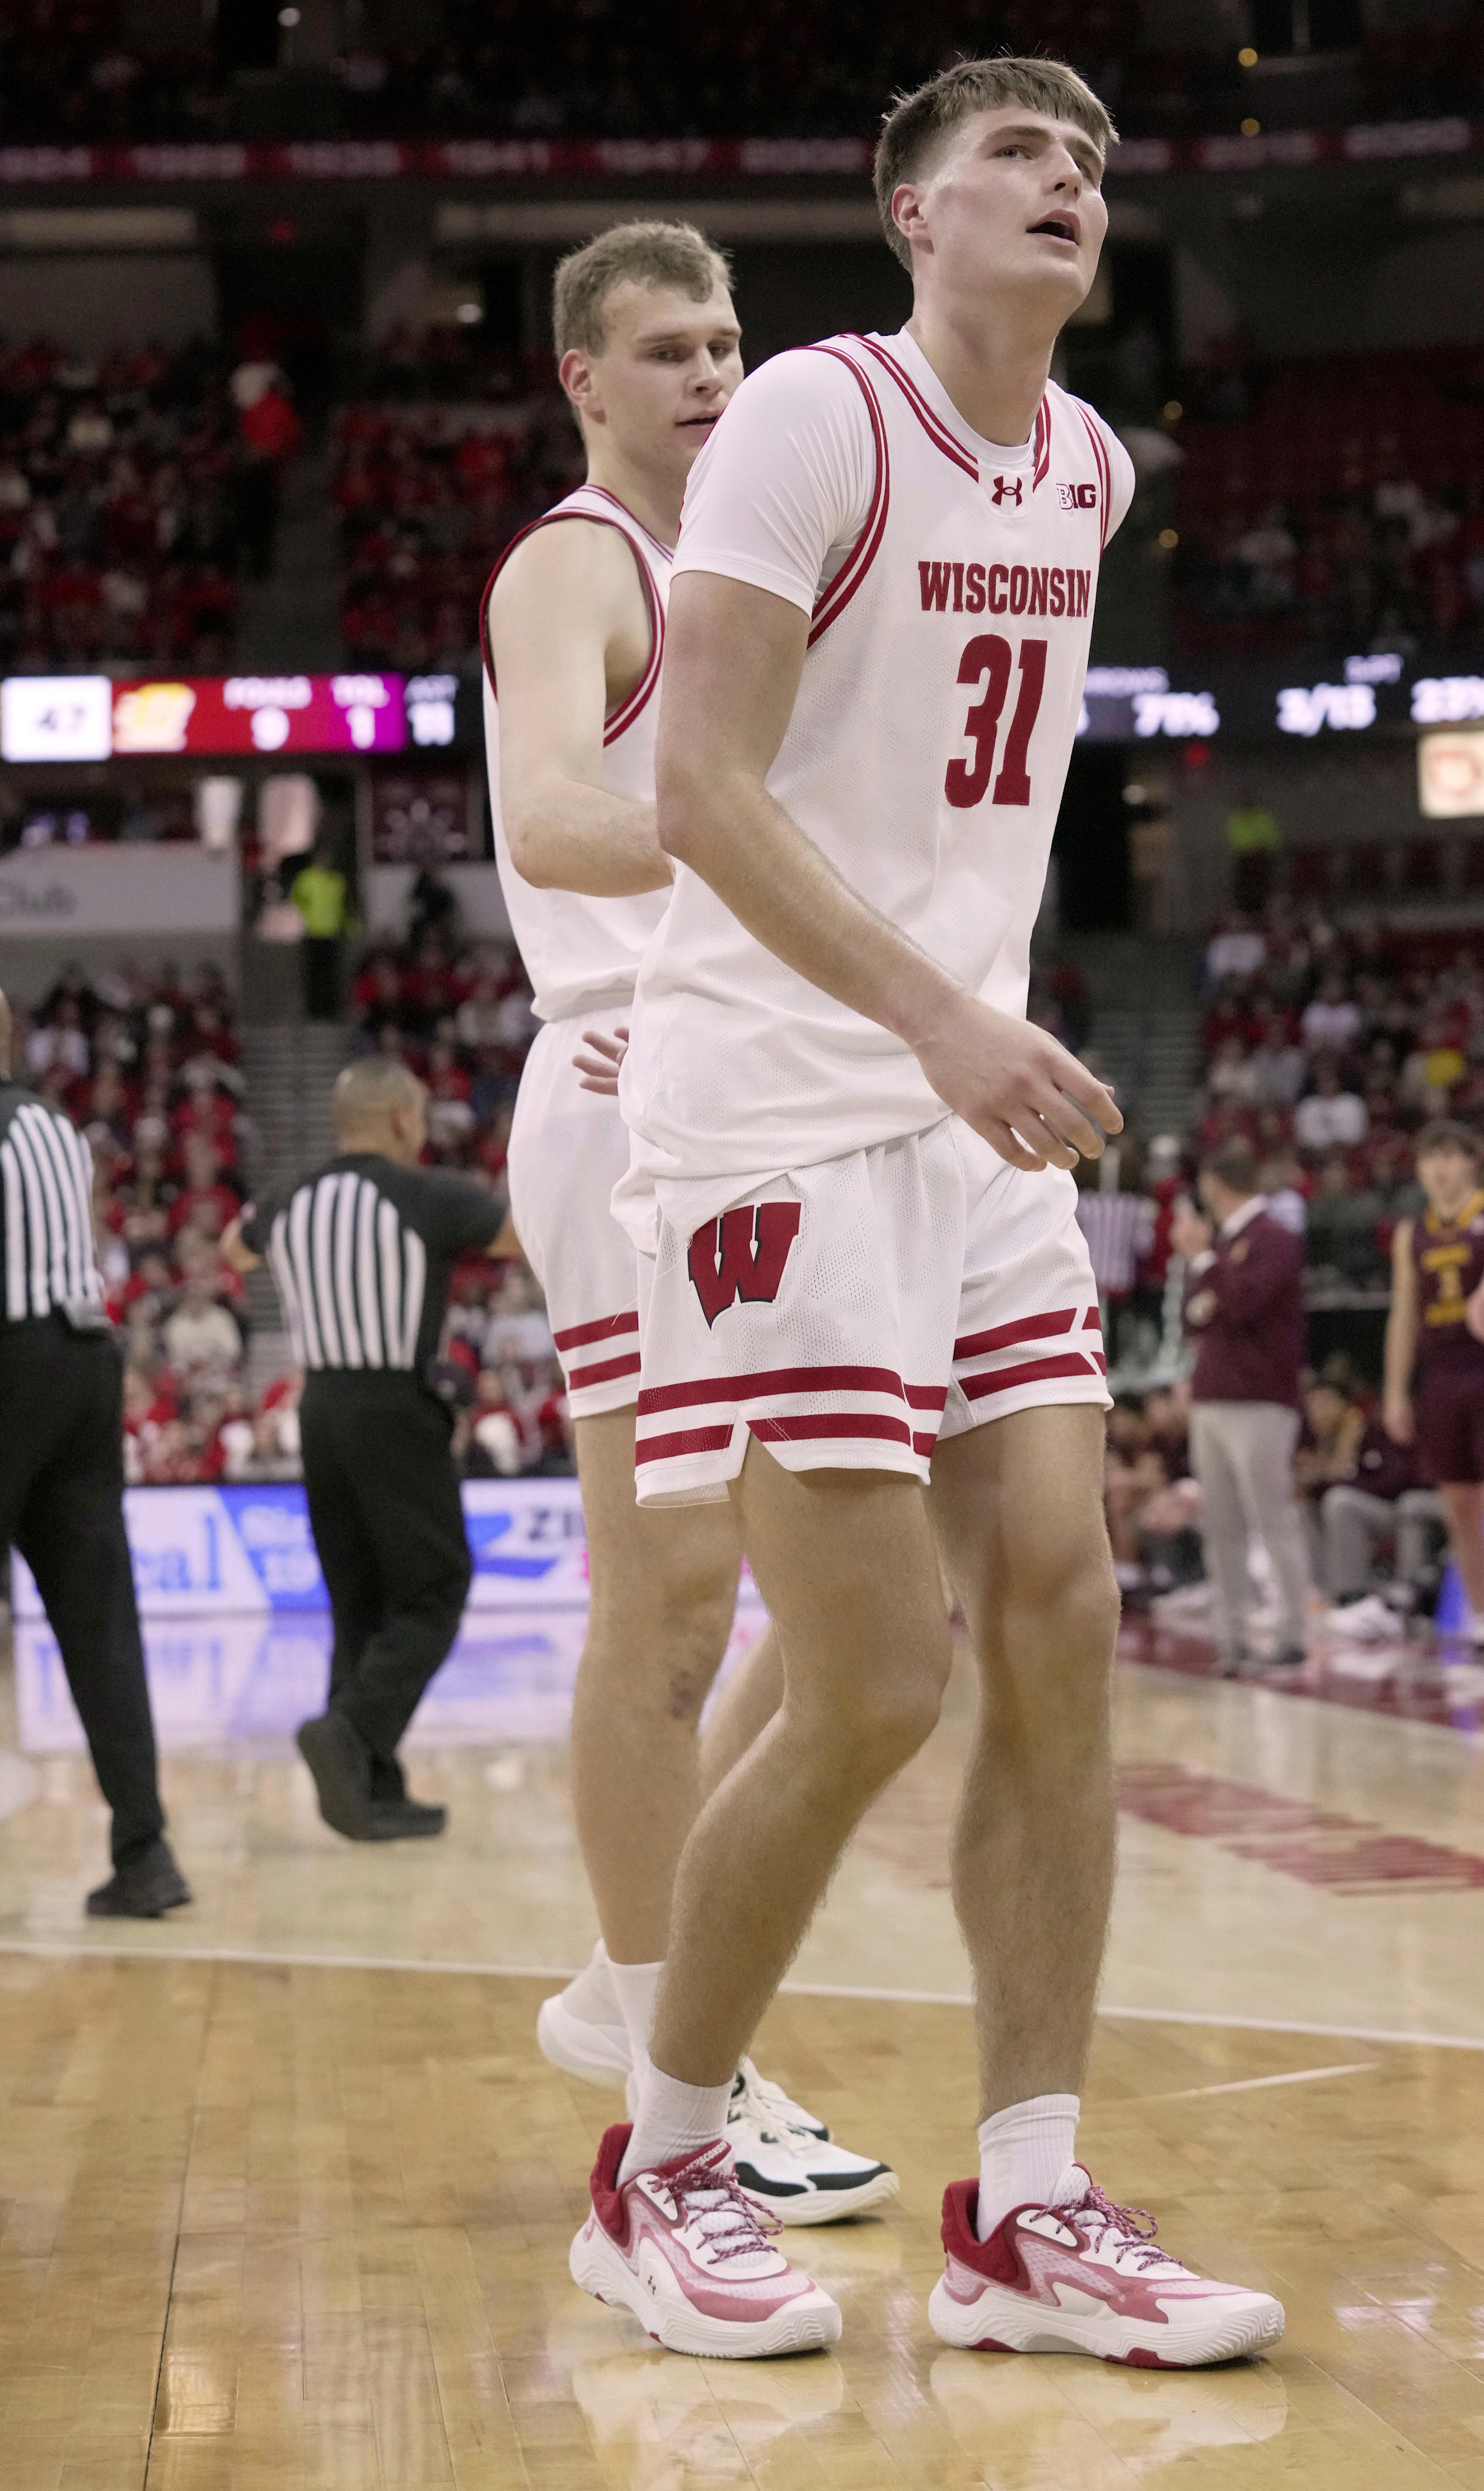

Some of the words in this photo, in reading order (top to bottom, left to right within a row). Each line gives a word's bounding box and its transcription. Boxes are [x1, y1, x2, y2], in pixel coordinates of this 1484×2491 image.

[1056, 483, 1096, 510] BIG
[918, 560, 1091, 618] WISCONSIN
[944, 634, 1048, 808] 31
[687, 1202, 802, 1331] W
